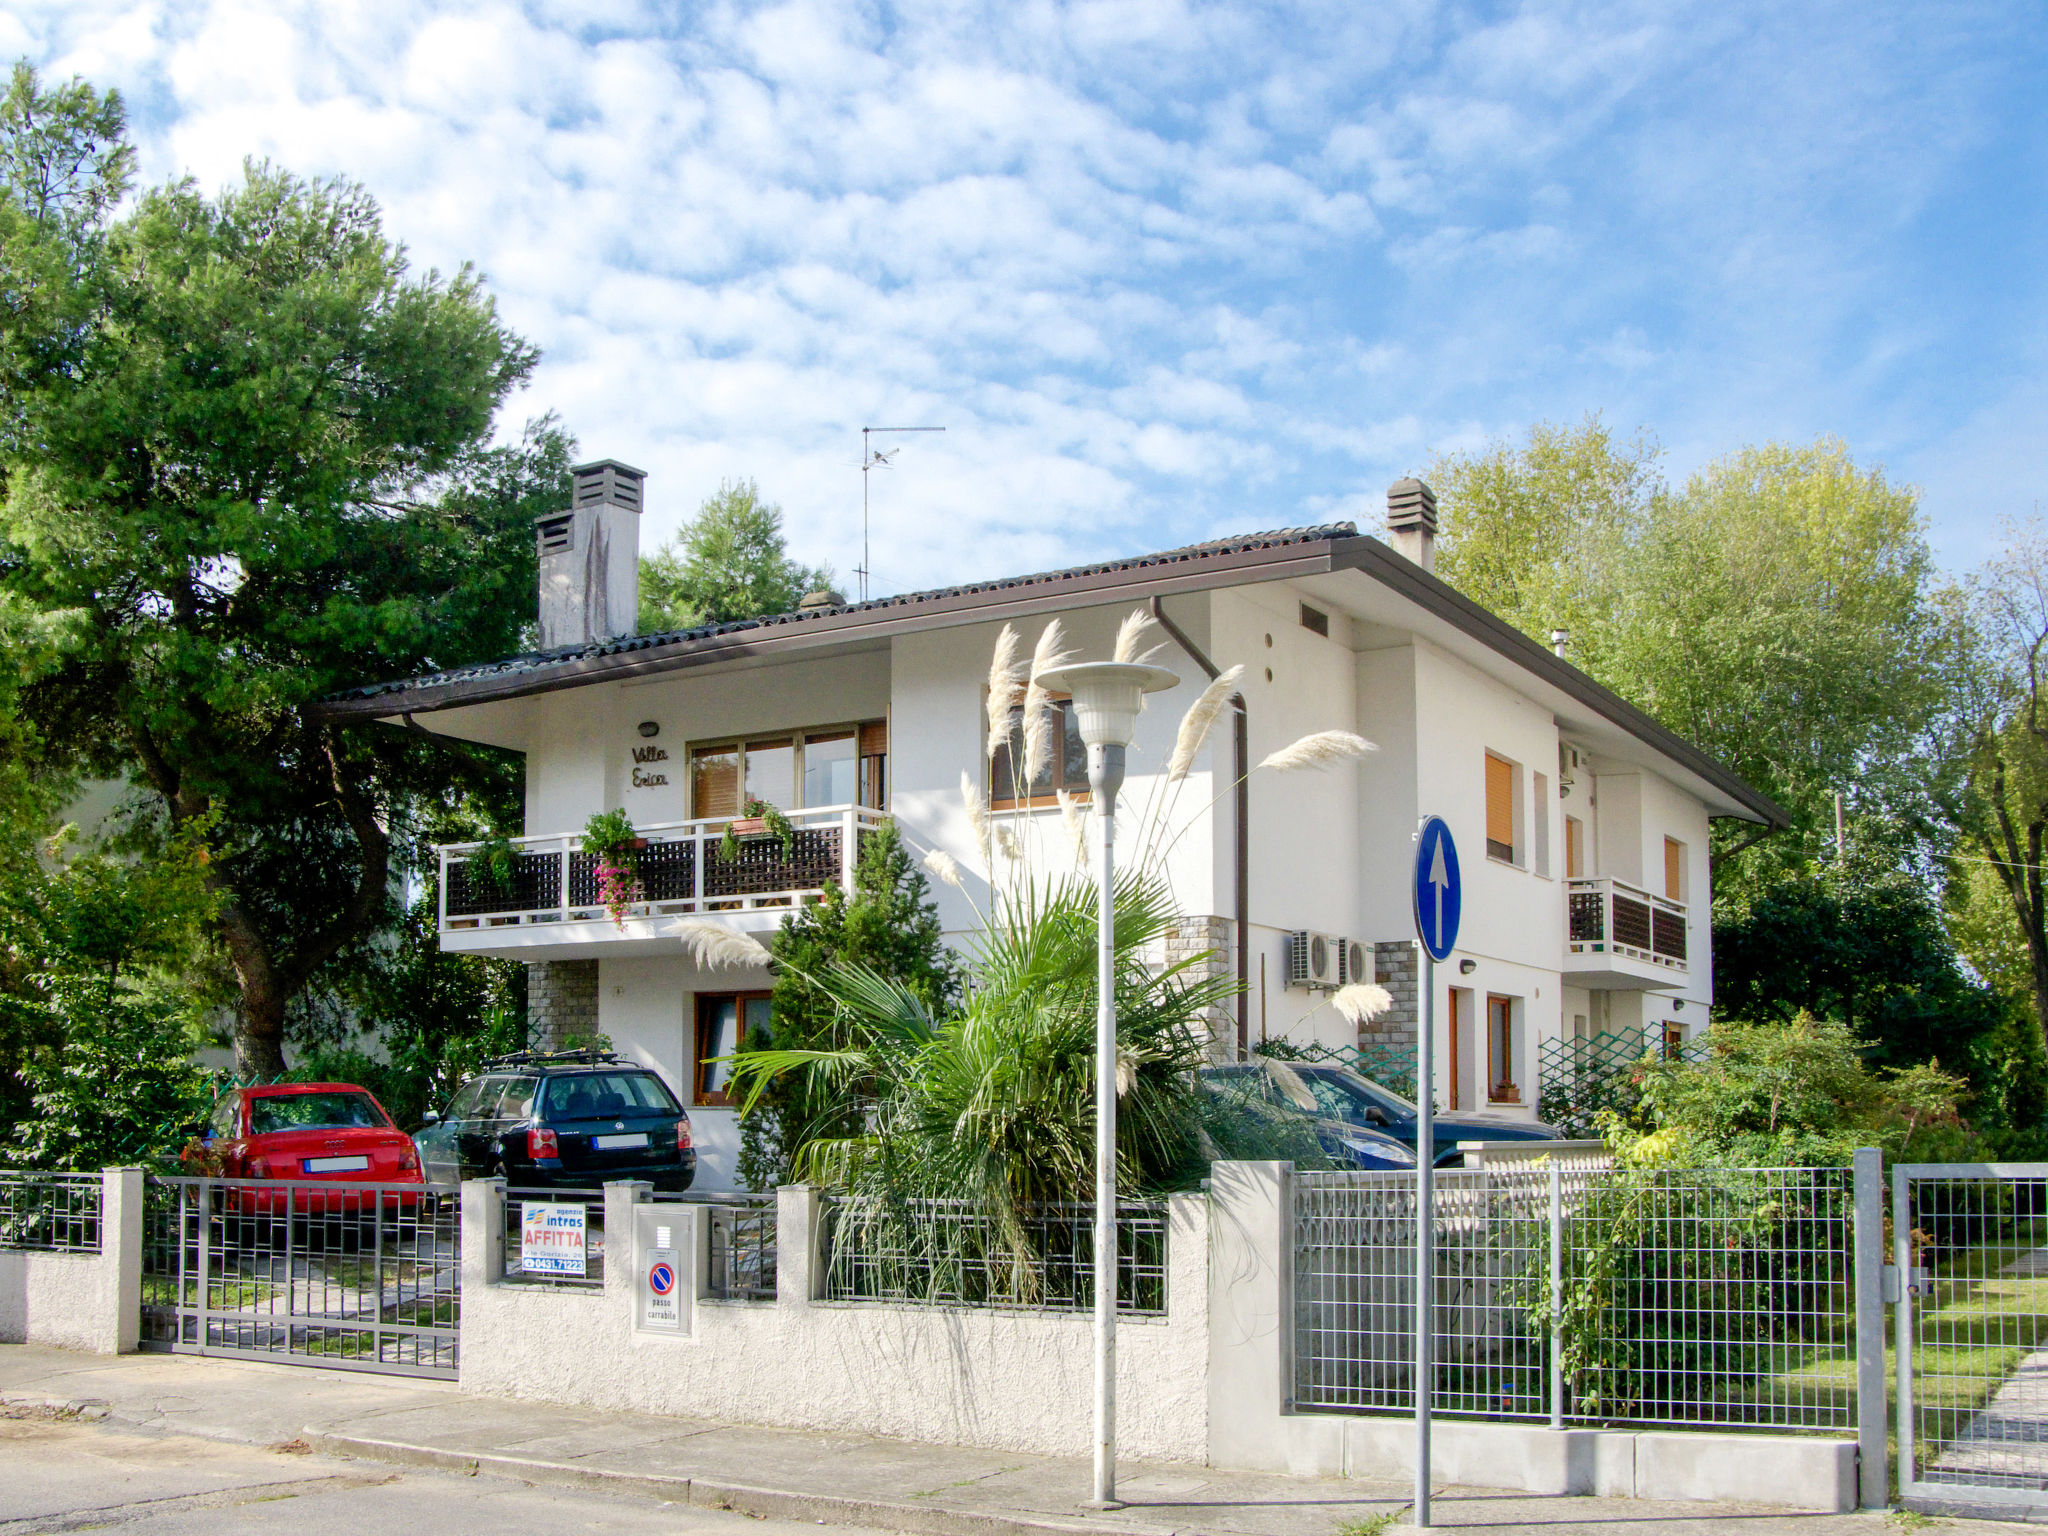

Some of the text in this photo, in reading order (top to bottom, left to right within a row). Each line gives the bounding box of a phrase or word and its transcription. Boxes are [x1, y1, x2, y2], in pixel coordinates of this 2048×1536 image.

[632, 746, 668, 763] Villa
[632, 767, 669, 788] Erica
[547, 1215, 583, 1227] intras
[524, 1229, 583, 1248] AFFITTA
[535, 1258, 584, 1270] 0431.71223
[652, 1299, 671, 1308] passo
[648, 1310, 676, 1321] carrabile
